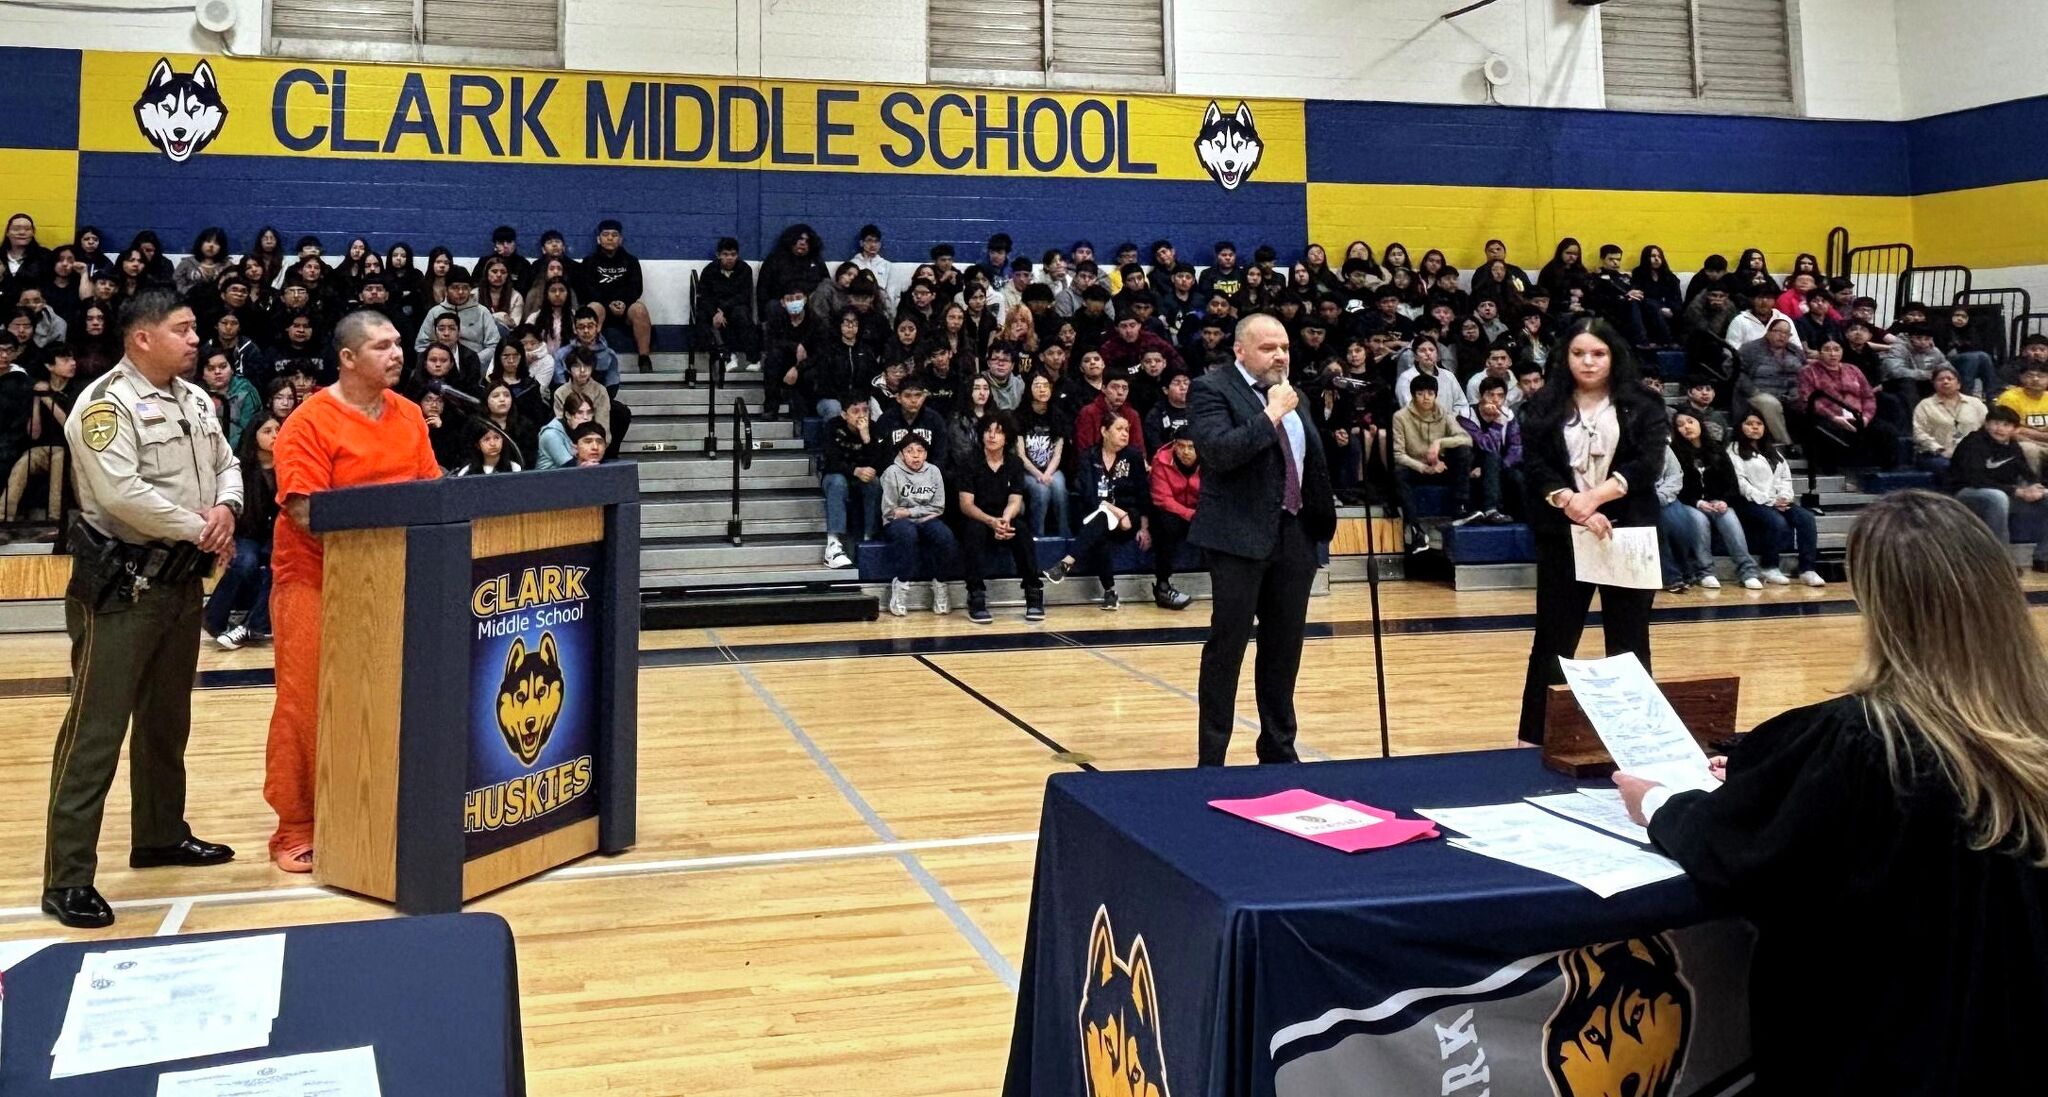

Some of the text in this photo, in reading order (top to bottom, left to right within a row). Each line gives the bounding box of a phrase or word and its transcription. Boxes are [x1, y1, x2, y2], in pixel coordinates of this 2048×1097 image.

[272, 69, 1158, 173] CLARK MIDDLE SCHOOL
[471, 566, 590, 618] CLARK
[477, 602, 584, 640] Middle School
[464, 755, 592, 832] HUSKIES
[1434, 1008, 1490, 1097] RK
